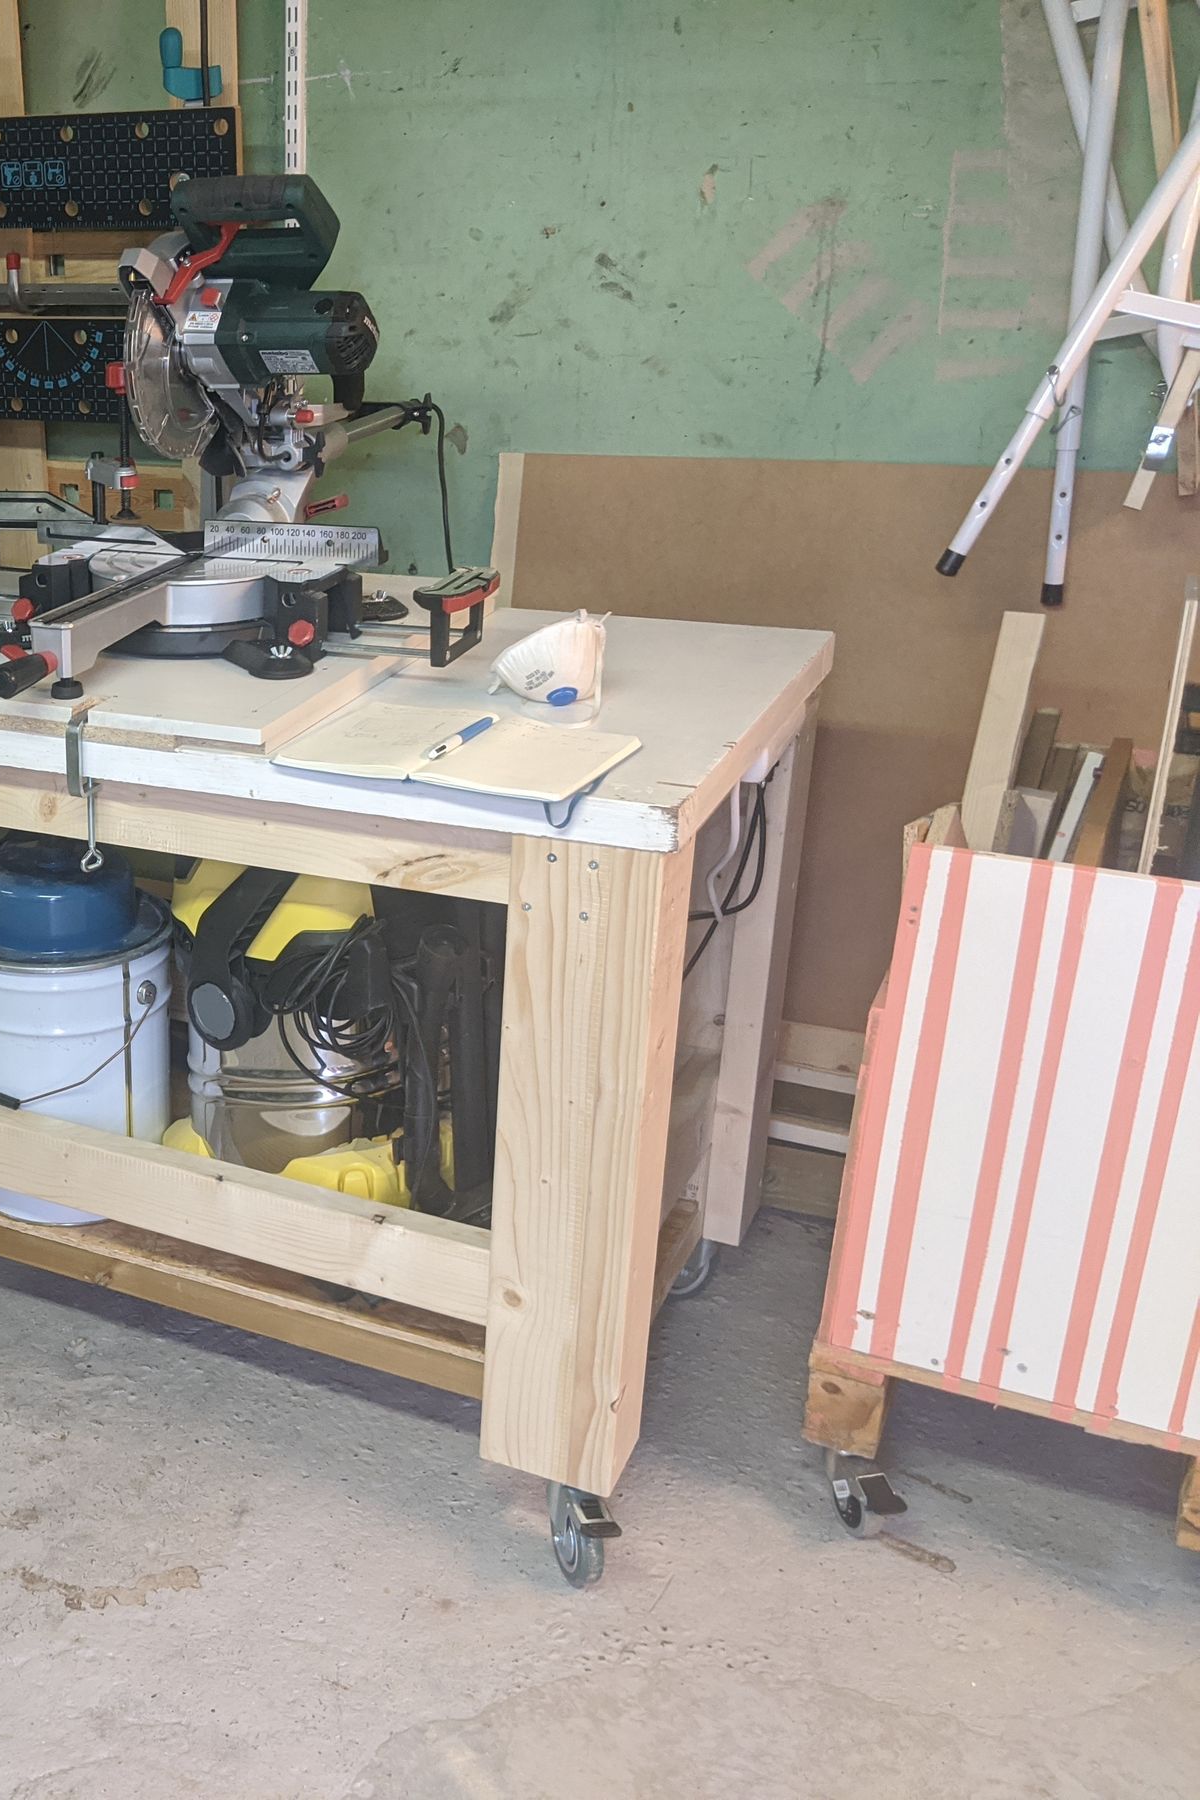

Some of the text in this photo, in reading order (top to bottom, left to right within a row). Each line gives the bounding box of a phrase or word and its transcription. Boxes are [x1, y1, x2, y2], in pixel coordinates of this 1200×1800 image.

[210, 525, 367, 540] 20 40 60 80 100 120 140 160 180 200
